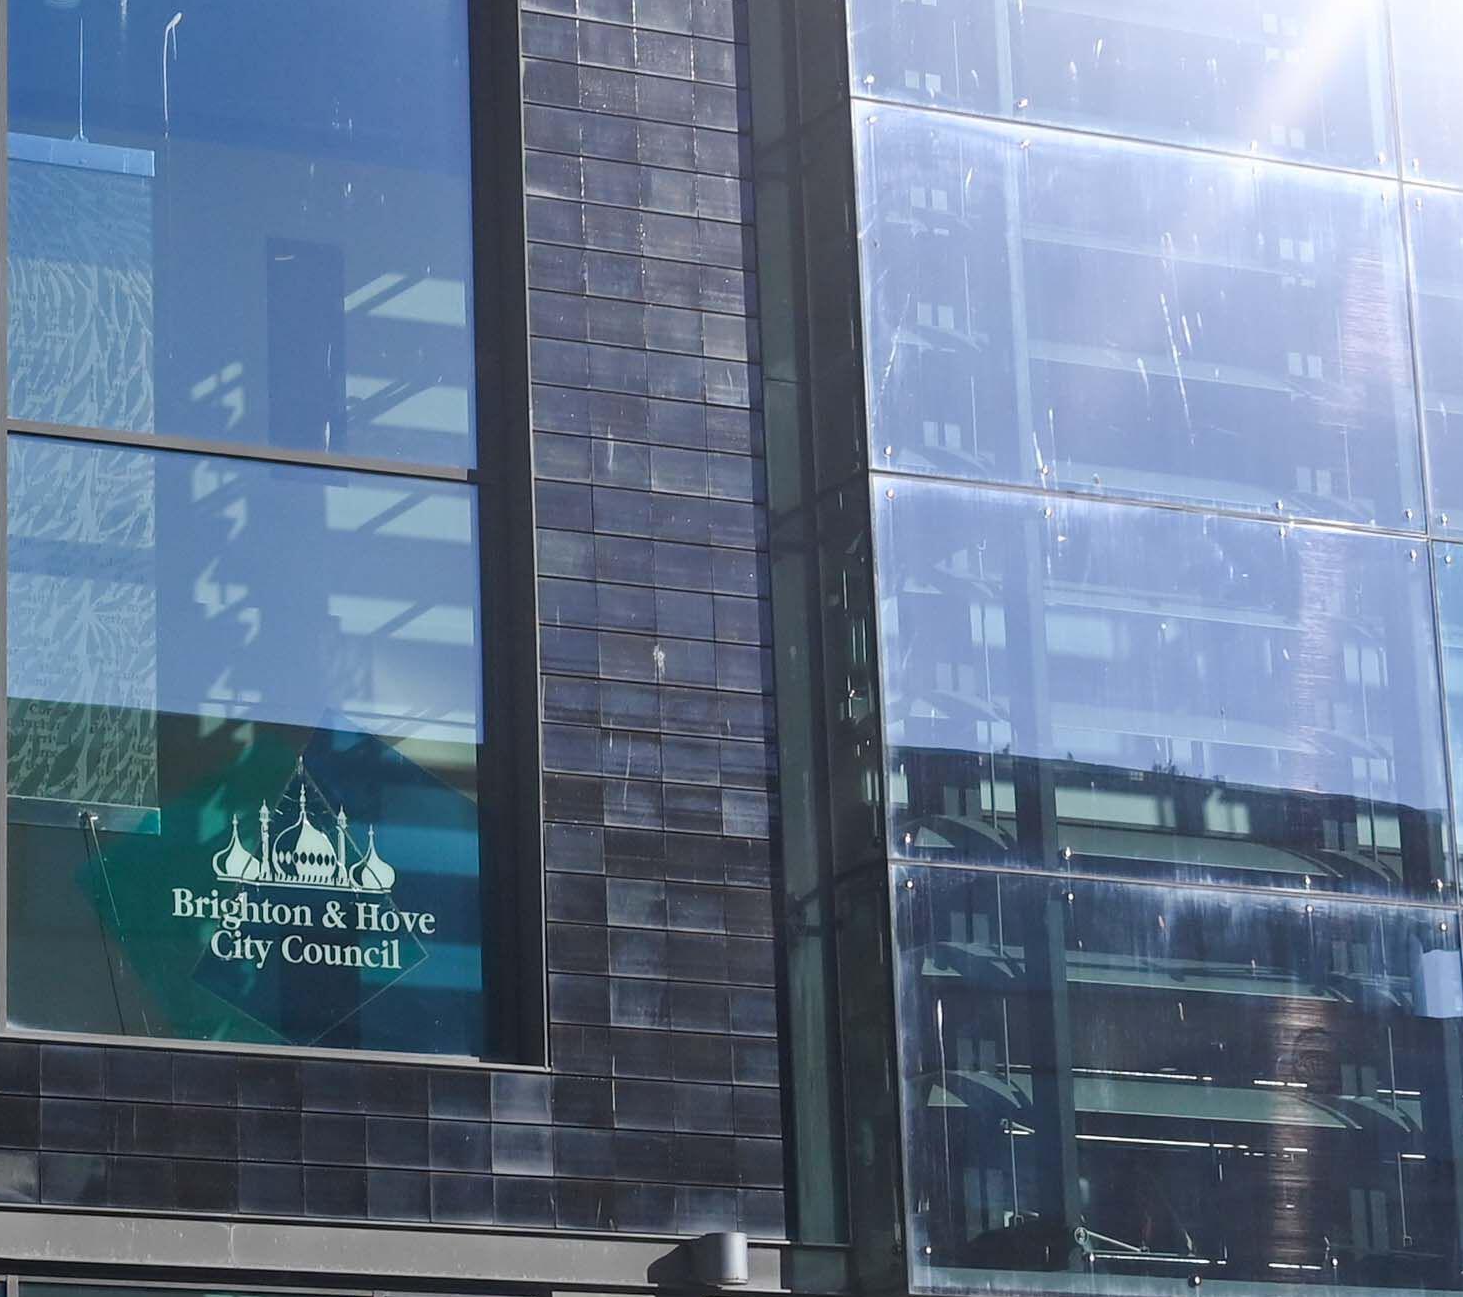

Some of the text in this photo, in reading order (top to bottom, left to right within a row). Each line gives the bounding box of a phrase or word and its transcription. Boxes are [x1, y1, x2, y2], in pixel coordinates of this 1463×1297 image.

[172, 888, 437, 935] Brighton & Hove
[211, 929, 403, 971] City Council
